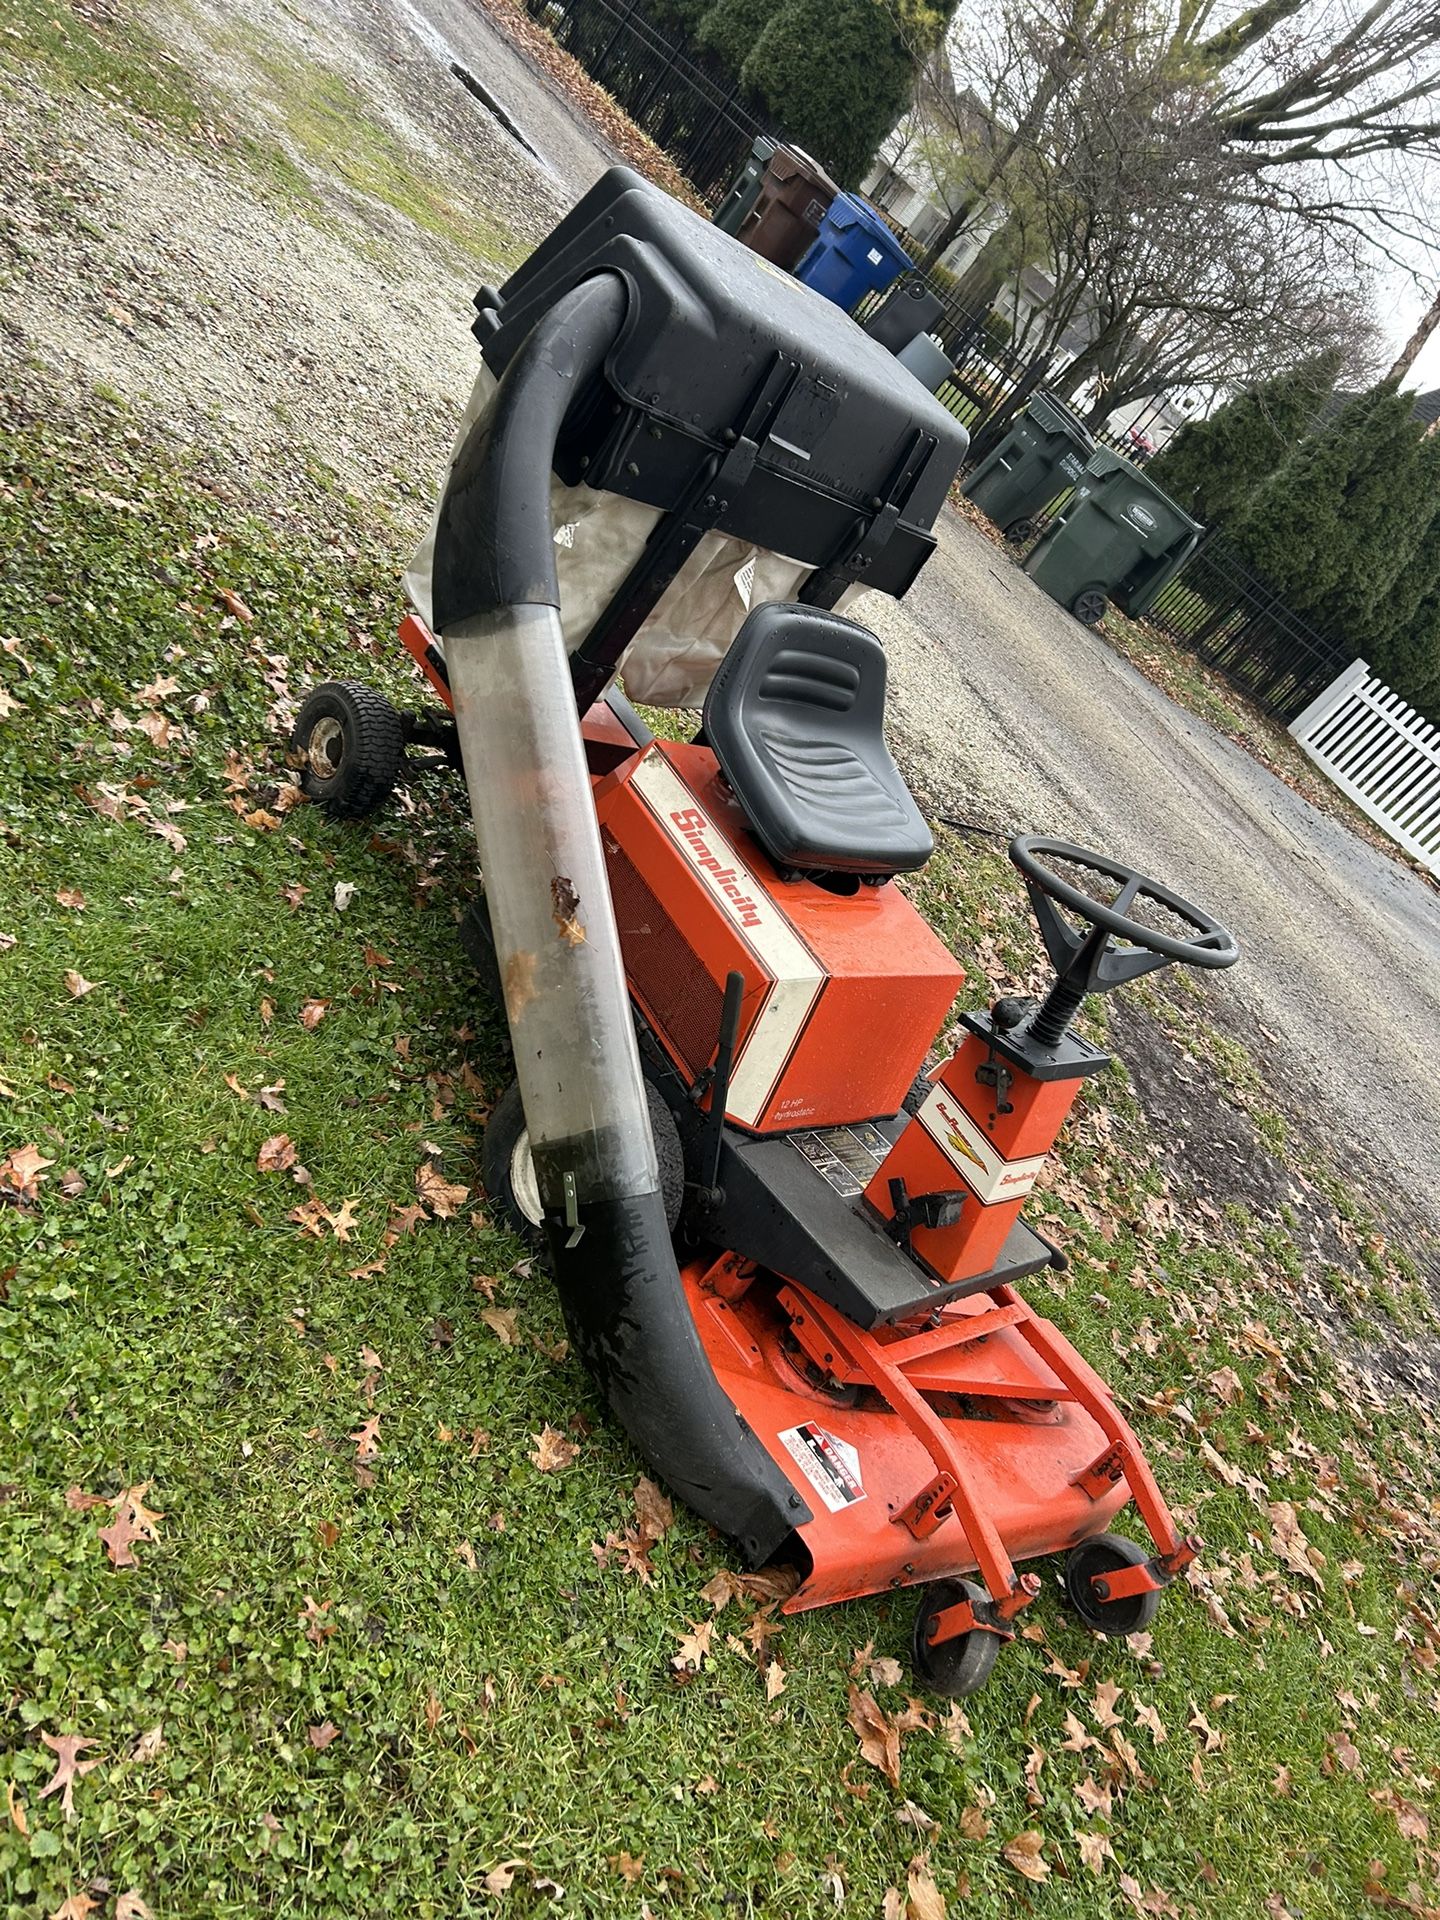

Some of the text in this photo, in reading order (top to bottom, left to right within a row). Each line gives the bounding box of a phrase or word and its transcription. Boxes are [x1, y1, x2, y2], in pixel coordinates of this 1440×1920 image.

[670, 809, 762, 927] Simplicity
[781, 1098, 804, 1109] 12 HP
[999, 1171, 1037, 1186] Simplicity
[824, 1447, 858, 1490] DANGER
